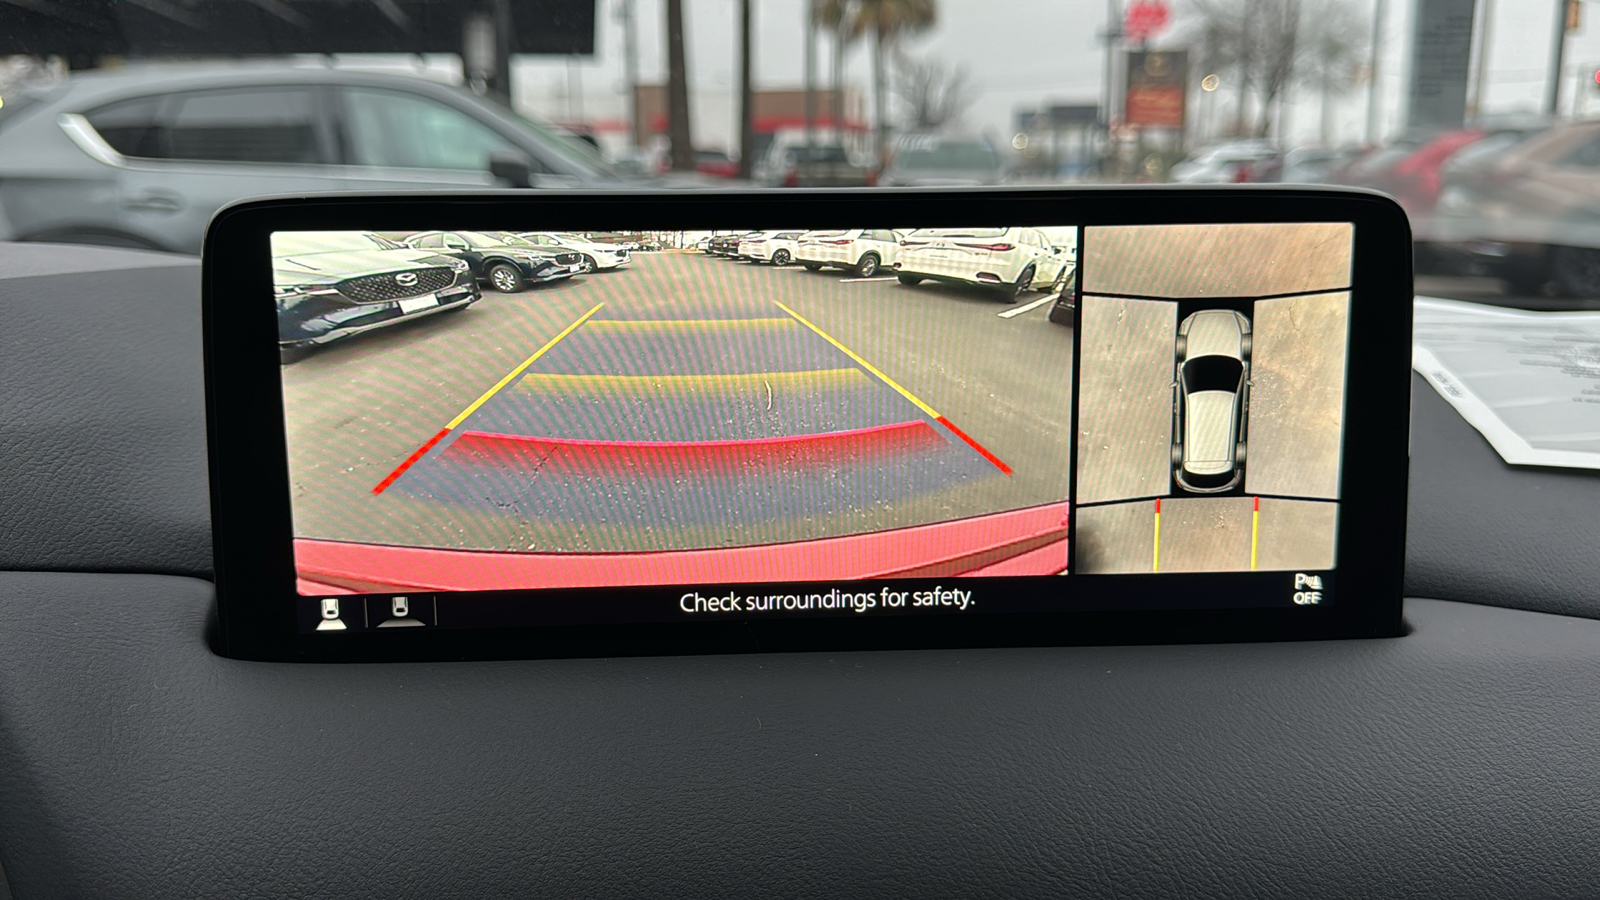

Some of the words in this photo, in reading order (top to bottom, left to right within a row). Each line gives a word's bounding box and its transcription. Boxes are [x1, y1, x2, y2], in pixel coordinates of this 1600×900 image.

[680, 591, 742, 613] Check
[746, 588, 876, 612] surroundings
[880, 587, 909, 607] for
[912, 586, 976, 611] safety.
[1293, 591, 1322, 605] OFF
